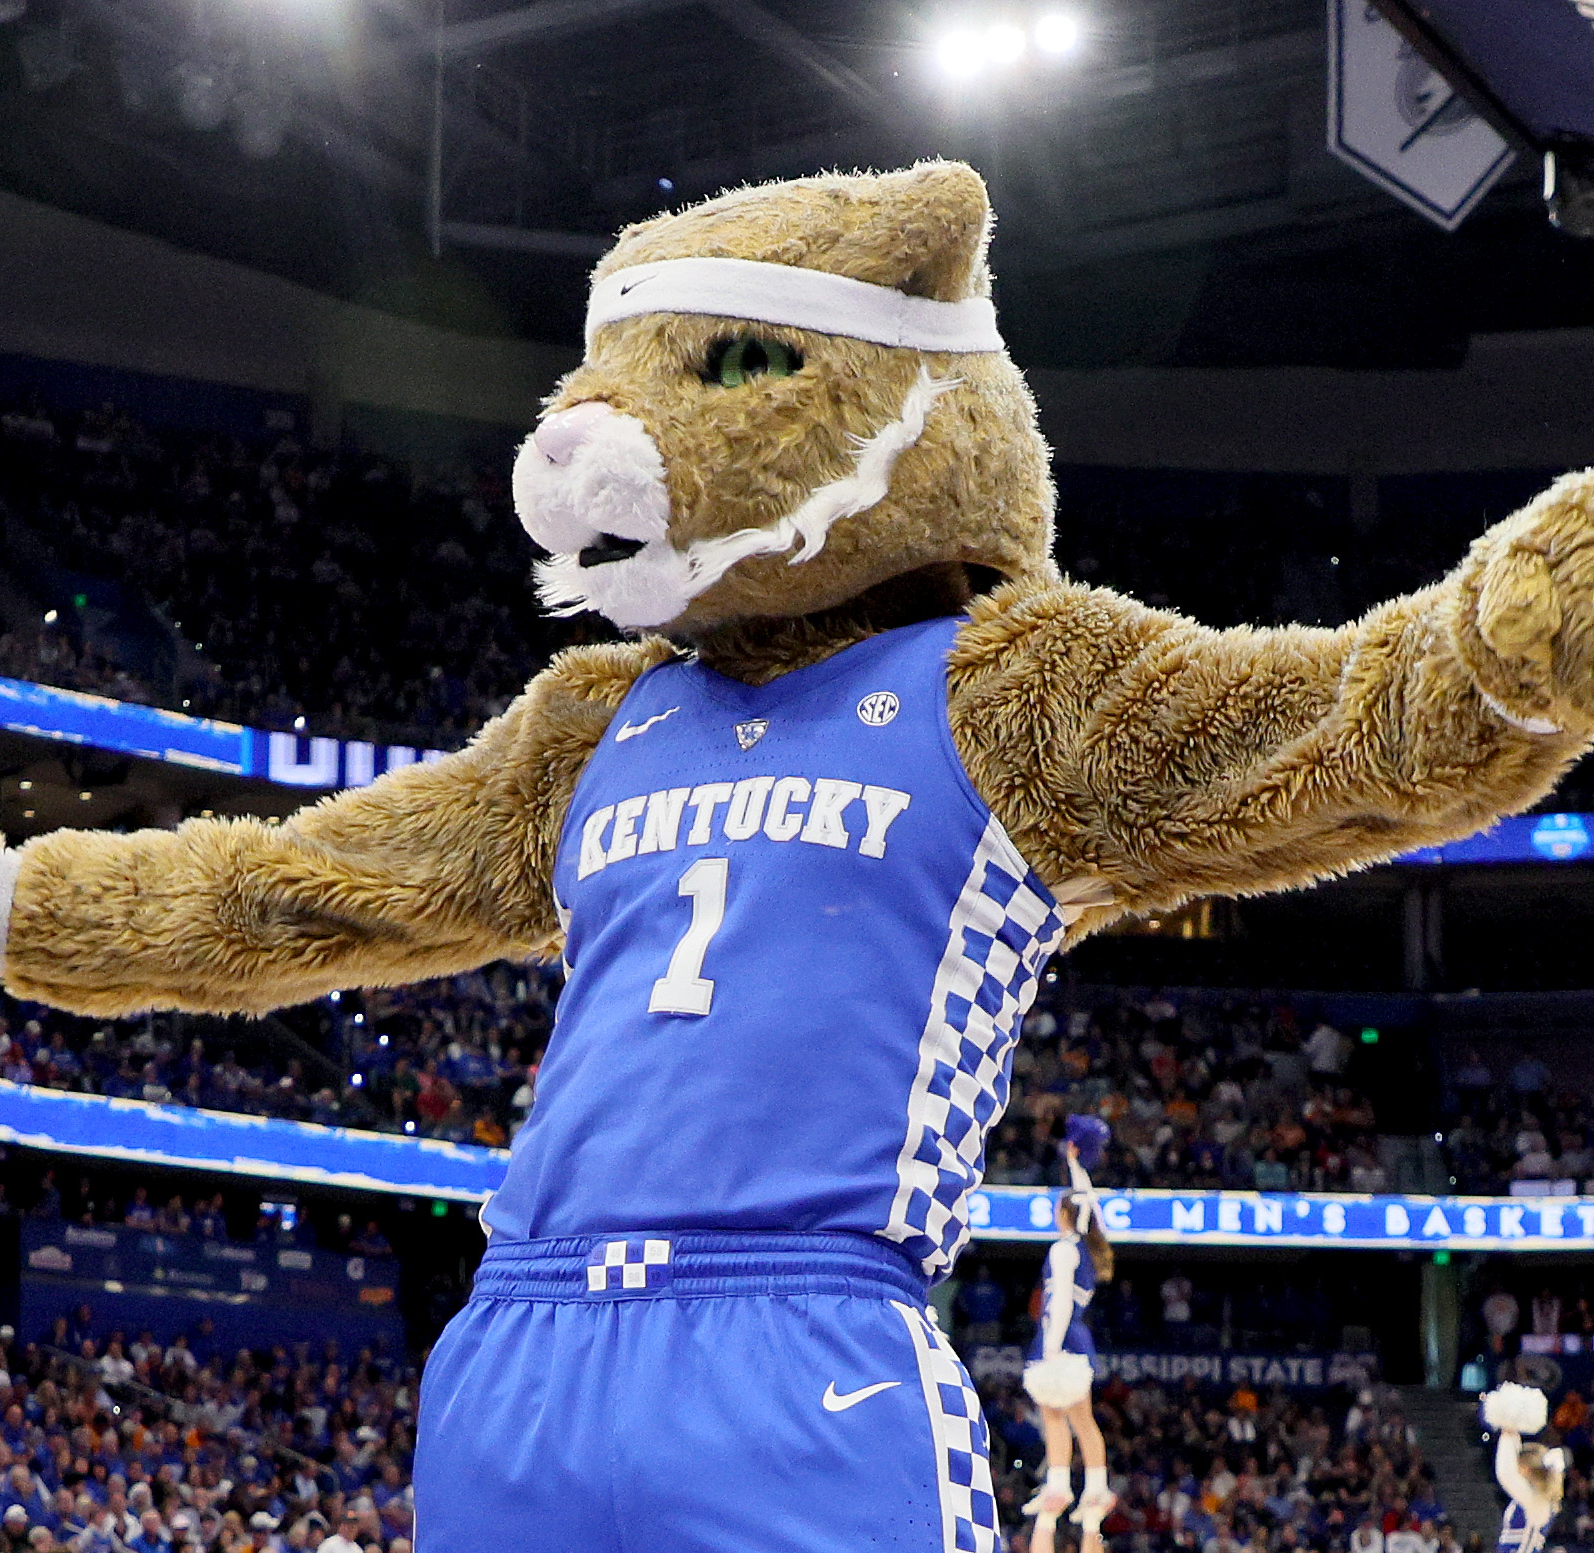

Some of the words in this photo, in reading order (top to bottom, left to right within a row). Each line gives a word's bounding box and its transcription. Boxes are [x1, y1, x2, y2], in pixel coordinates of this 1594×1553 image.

[860, 693, 897, 725] SEC
[577, 775, 912, 881] KENTUCKY
[648, 857, 730, 1017] 1
[1029, 1197, 1132, 1231] SC
[1171, 1198, 1347, 1236] MEN'S
[1227, 1355, 1324, 1386] STATE
